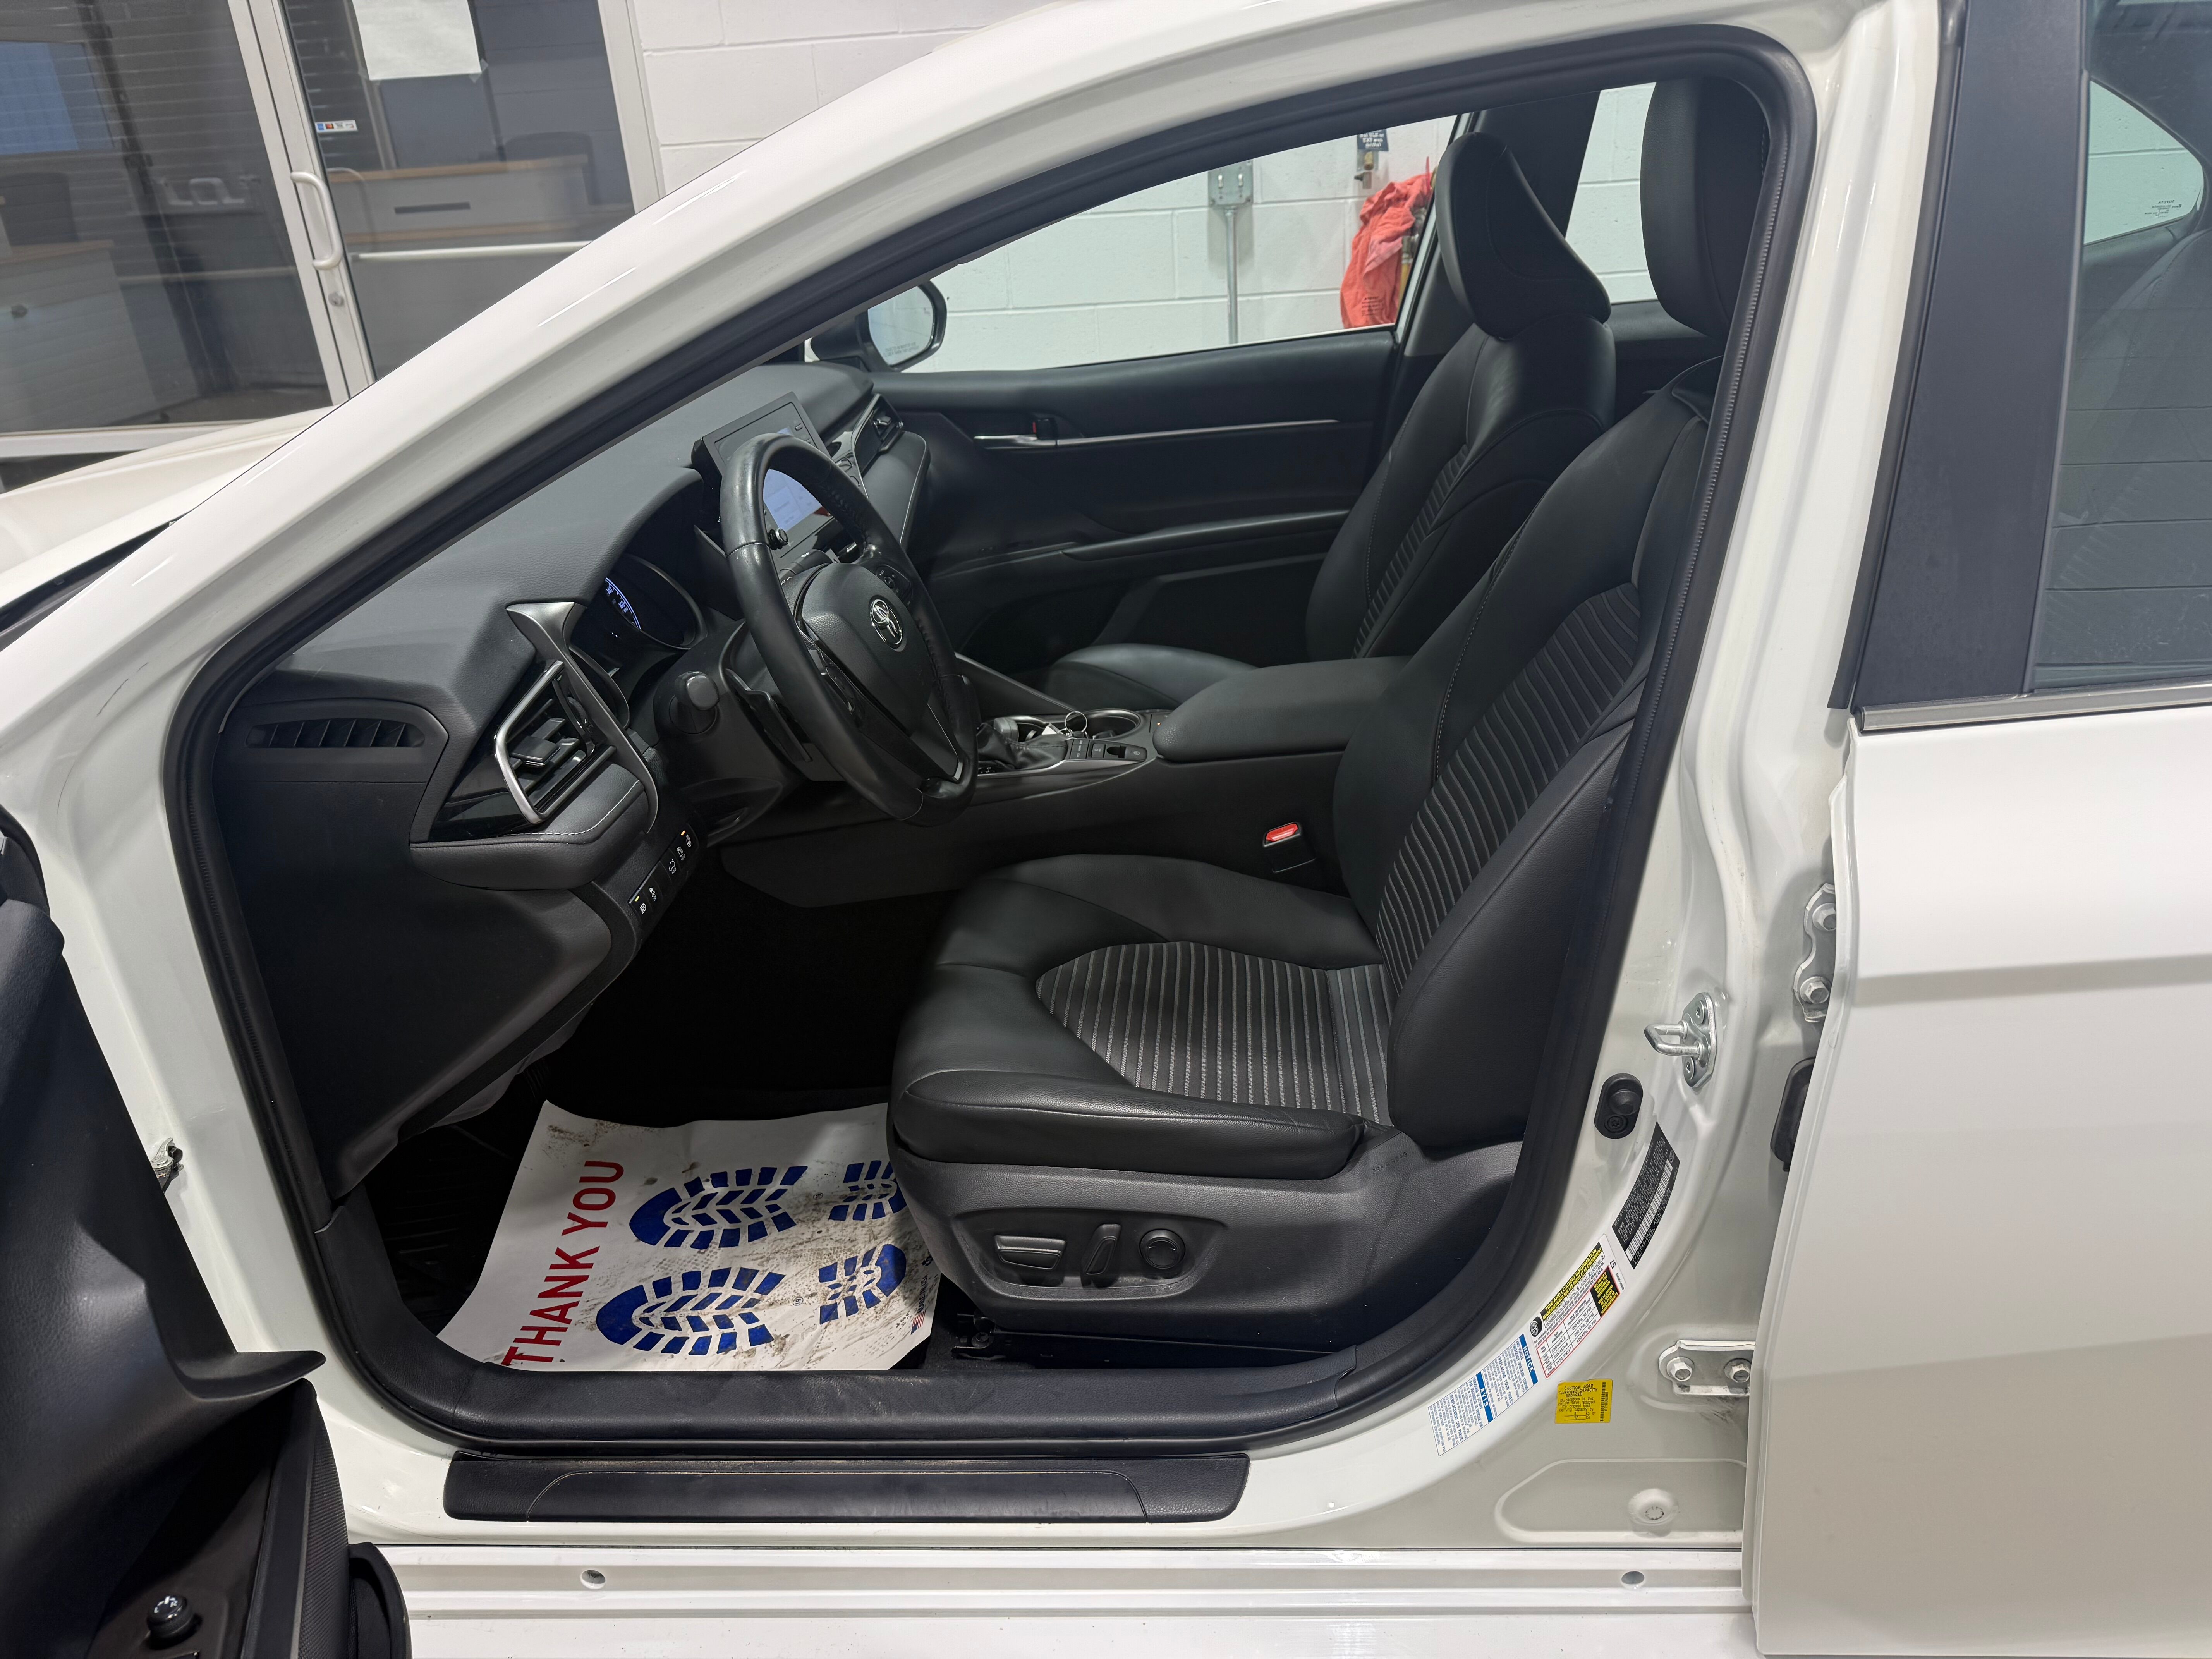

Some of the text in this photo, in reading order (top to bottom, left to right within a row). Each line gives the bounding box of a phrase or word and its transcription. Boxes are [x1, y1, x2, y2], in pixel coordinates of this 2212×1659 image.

[501, 1161, 624, 1366] THANK YOU
[1561, 1276, 1575, 1293] LOADING
[1575, 1250, 1596, 1274] INFORMATION
[1523, 1345, 1533, 1372] NOTICE
